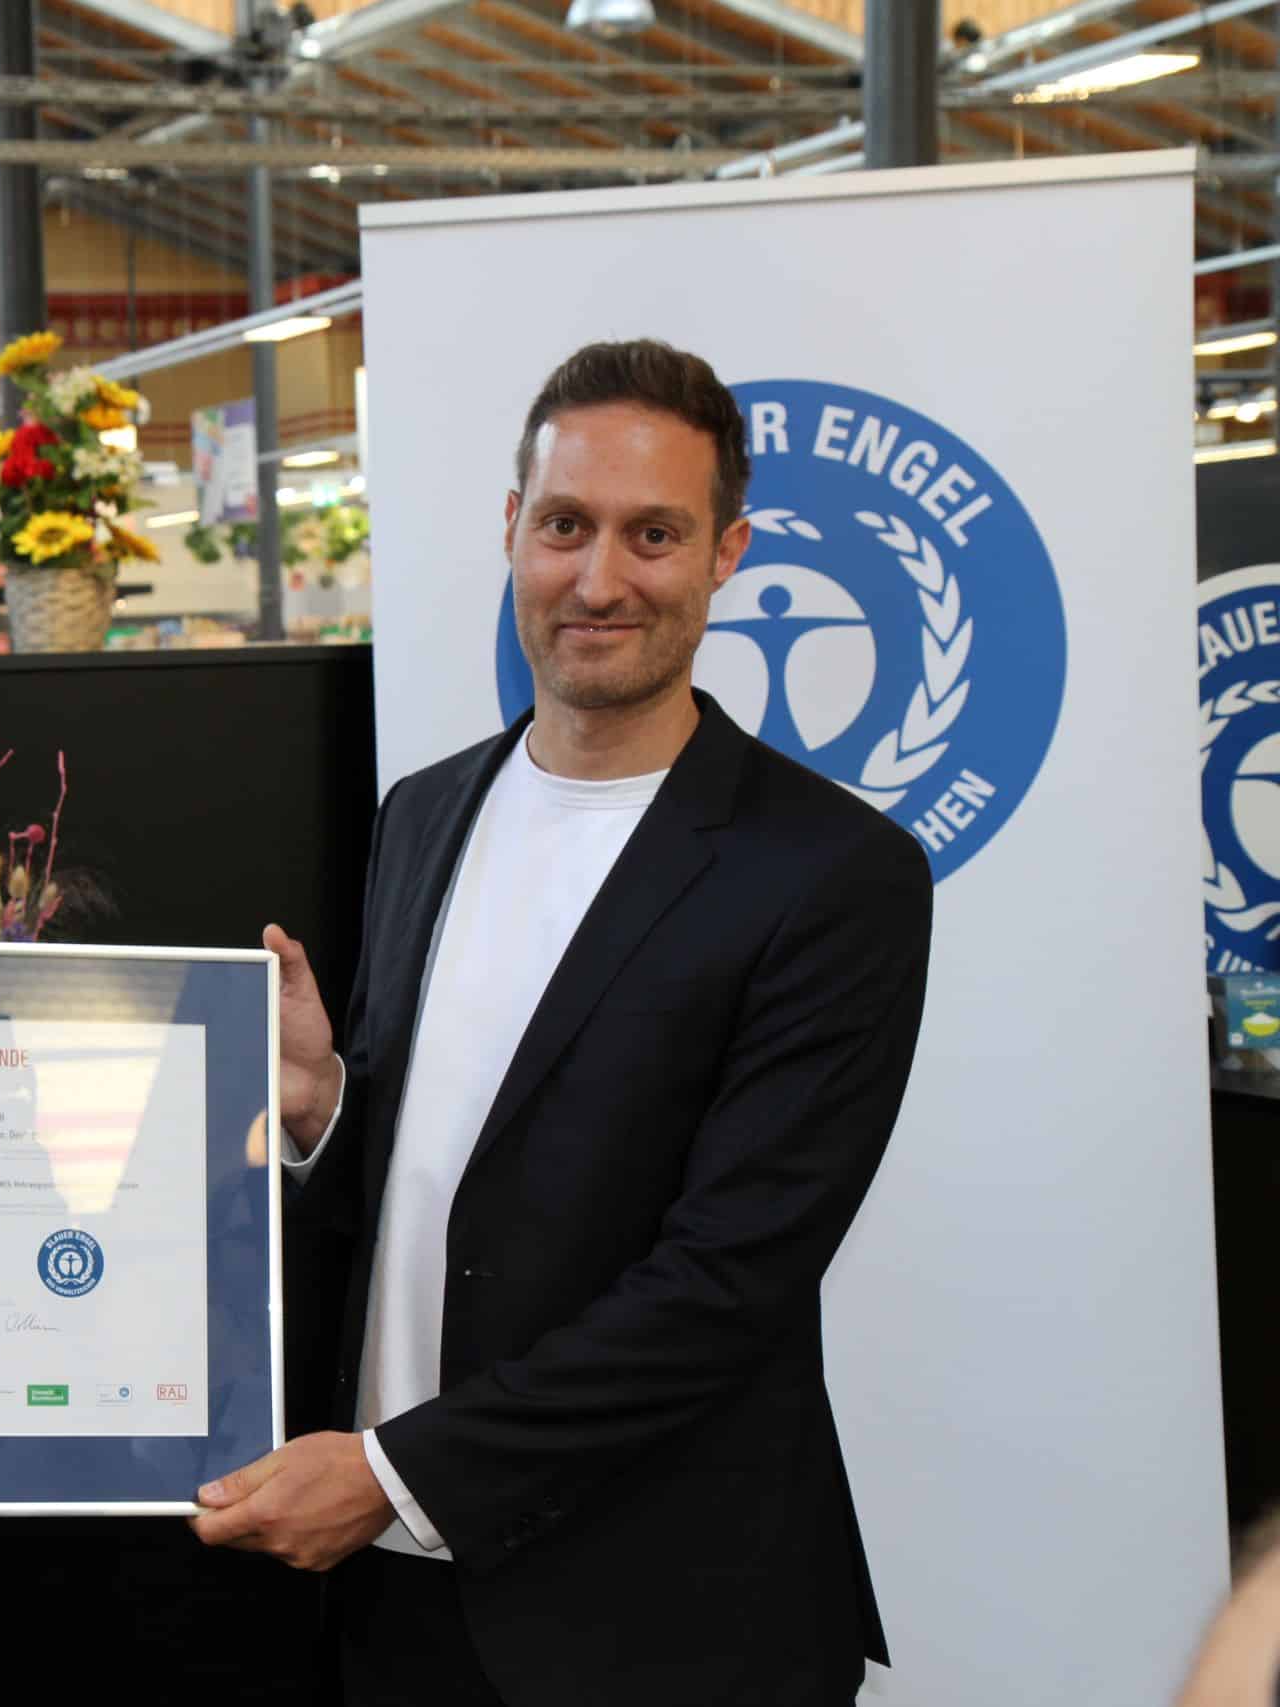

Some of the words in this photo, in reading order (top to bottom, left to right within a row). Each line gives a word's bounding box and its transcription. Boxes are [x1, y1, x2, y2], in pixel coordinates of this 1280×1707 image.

[746, 401, 790, 455] R
[813, 403, 994, 548] ENGEL
[911, 768, 996, 852] HEN
[159, 1386, 185, 1399] RAL
